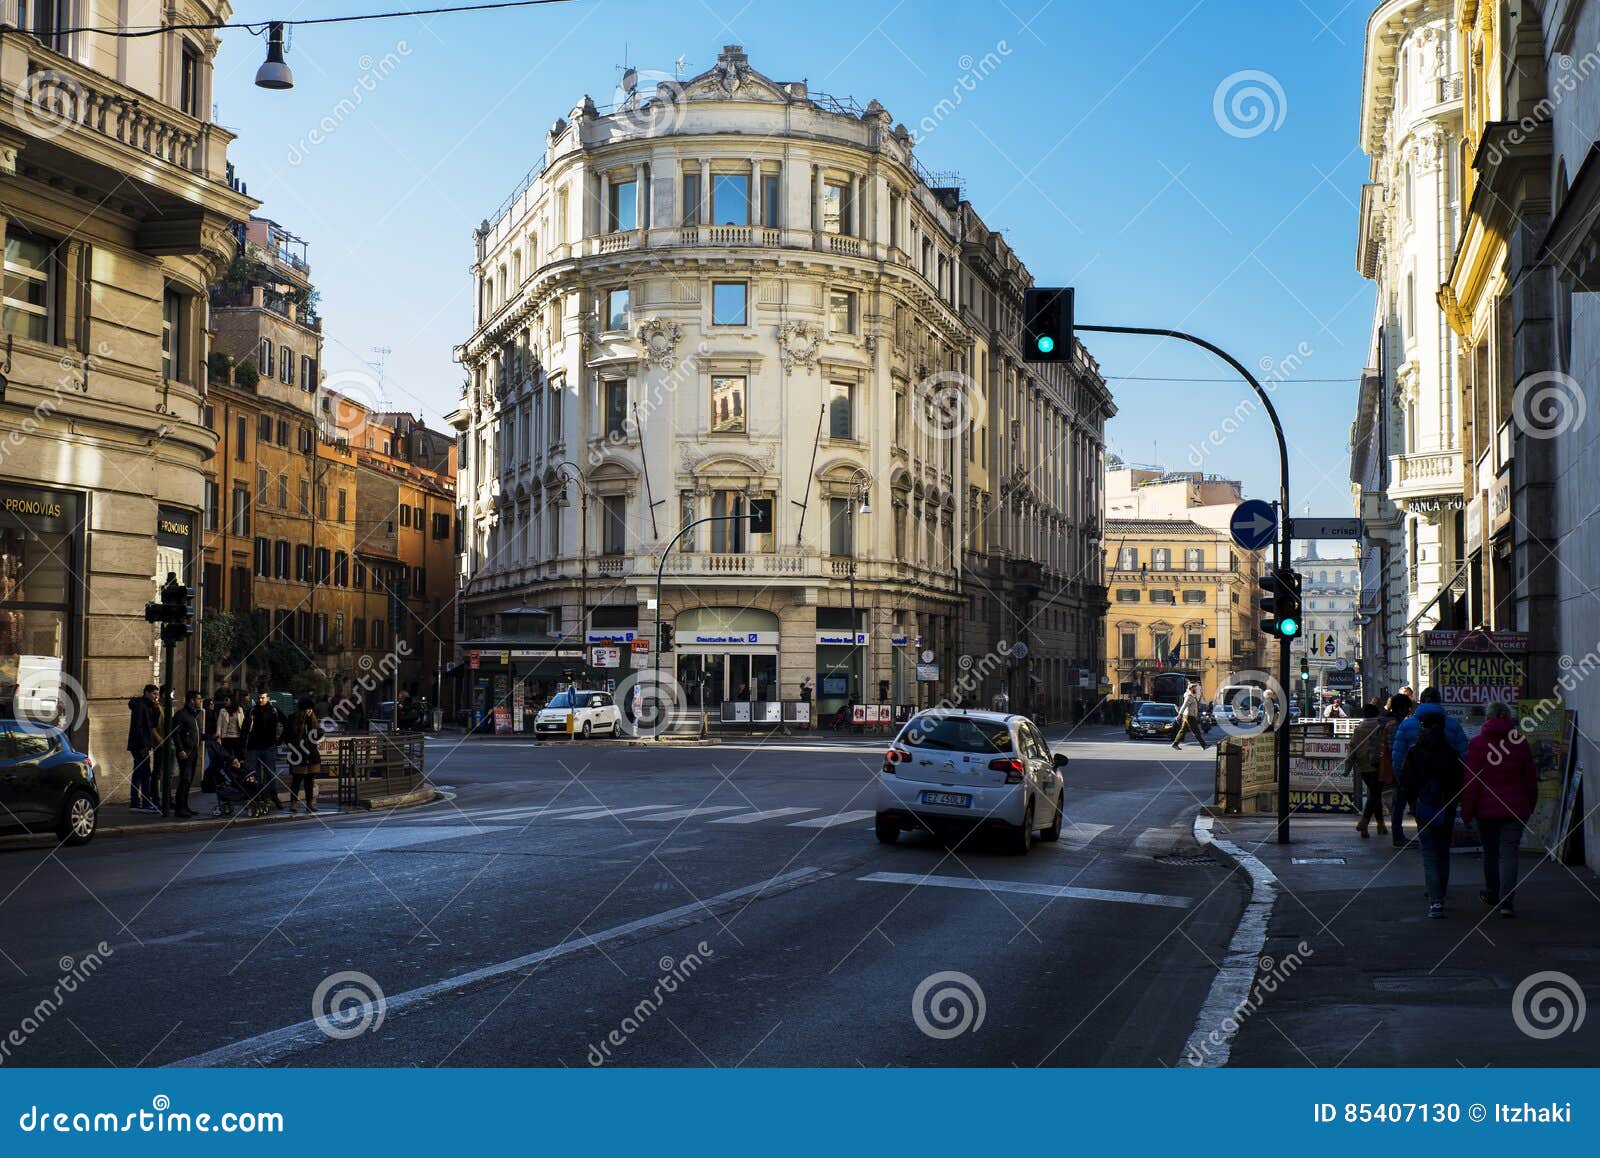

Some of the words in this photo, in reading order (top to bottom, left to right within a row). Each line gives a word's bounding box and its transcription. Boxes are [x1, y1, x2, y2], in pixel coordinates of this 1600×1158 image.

[6, 498, 61, 518] PRONOVIAS
[1408, 499, 1441, 513] BANCA
[160, 520, 189, 537] PRONOVIAS
[1331, 527, 1358, 537] crispi
[1440, 657, 1521, 675] EXCHANGE
[1444, 686, 1520, 703] EXCHANGE
[1289, 791, 1324, 805] MINI
